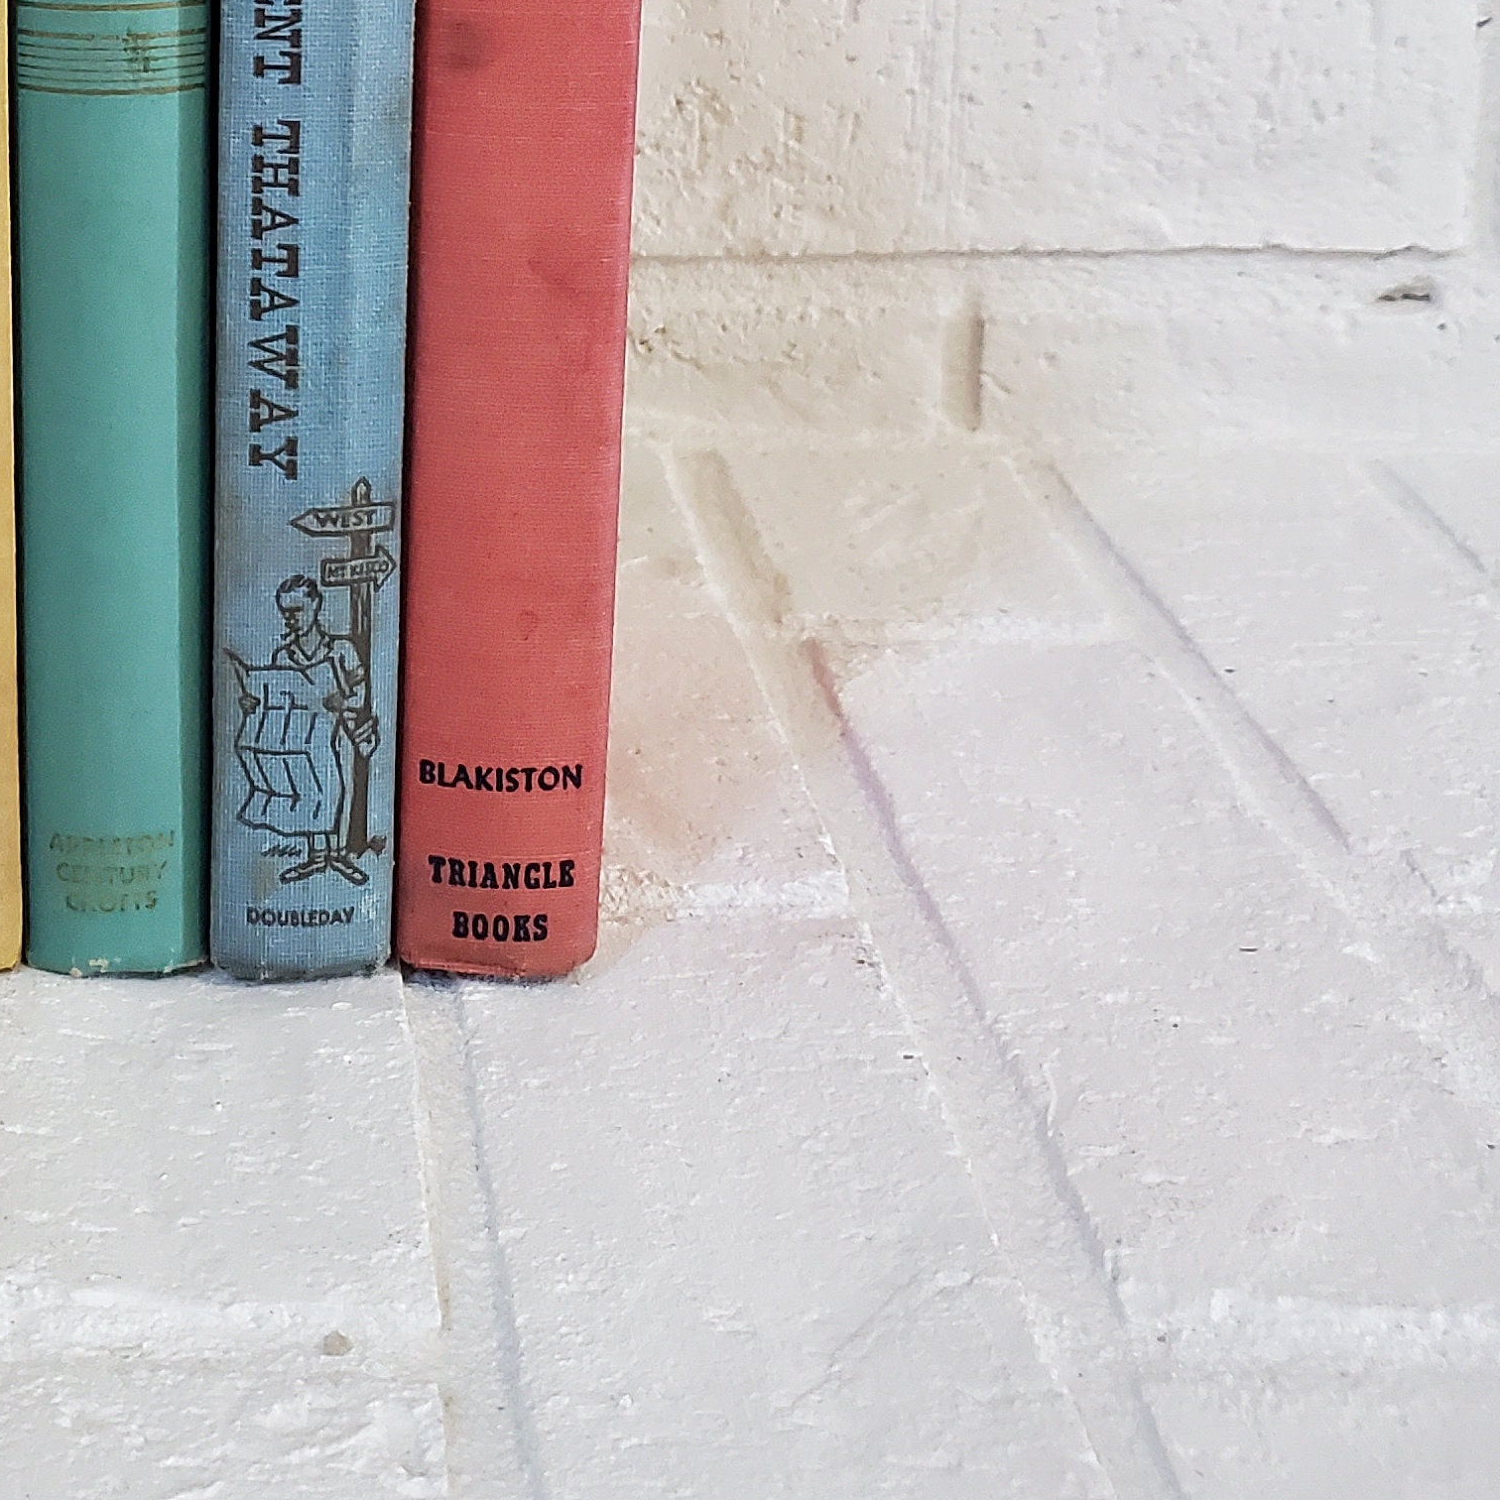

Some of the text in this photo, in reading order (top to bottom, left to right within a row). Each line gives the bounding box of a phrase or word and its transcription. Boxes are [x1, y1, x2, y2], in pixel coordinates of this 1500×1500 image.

[248, 119, 301, 481] THATAWAY
[419, 759, 583, 792] BLAKISTON
[428, 855, 575, 889] TRIANGLE
[246, 906, 354, 927] DOUBLEDAY
[452, 911, 548, 942] BOOKS
